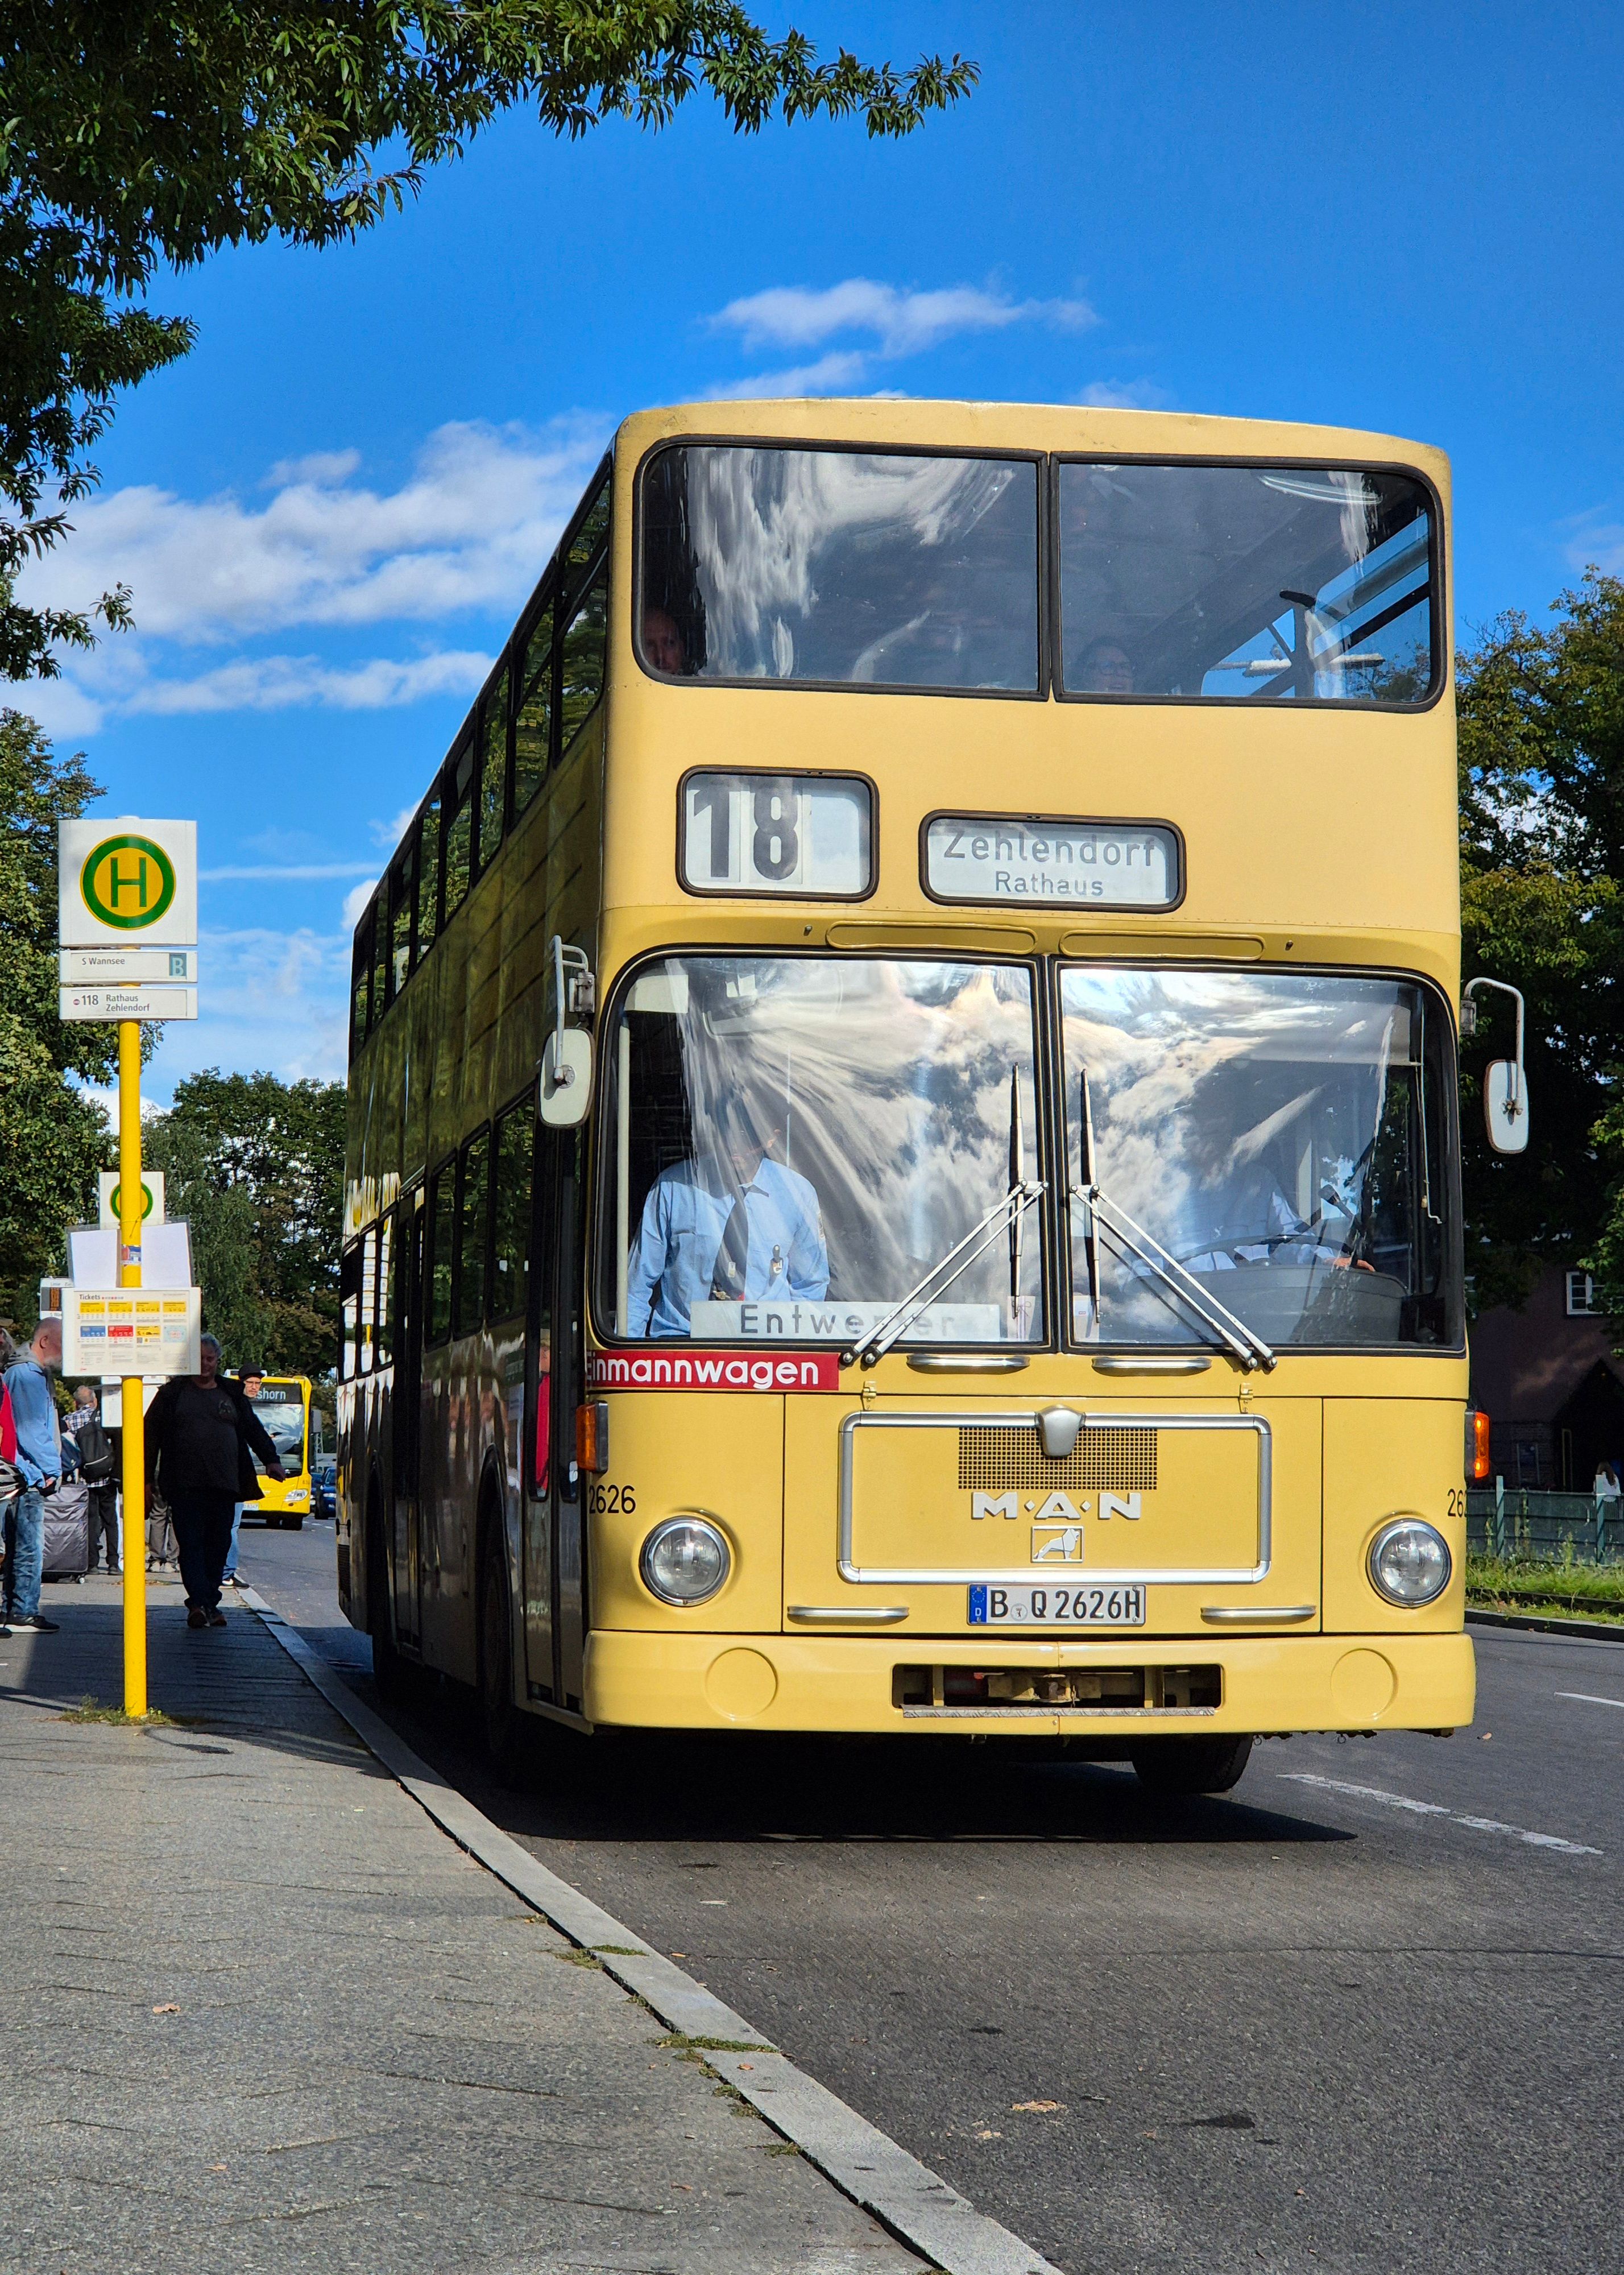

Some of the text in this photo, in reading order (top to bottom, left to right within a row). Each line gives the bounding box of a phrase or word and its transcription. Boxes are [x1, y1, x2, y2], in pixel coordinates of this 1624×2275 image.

[694, 781, 799, 880] 18
[943, 830, 1155, 867] Zehlendorf
[110, 857, 147, 908] H
[995, 870, 1104, 897] Rathaus
[172, 957, 184, 977] B
[81, 995, 99, 1006] 118
[106, 1003, 150, 1012] Zehlendorf
[740, 1304, 955, 1336] Entweer
[256, 1388, 286, 1400] shorn
[589, 1484, 636, 1515] 2626
[975, 1607, 982, 1616] D
[990, 1589, 1141, 1619] B Q 2626H
